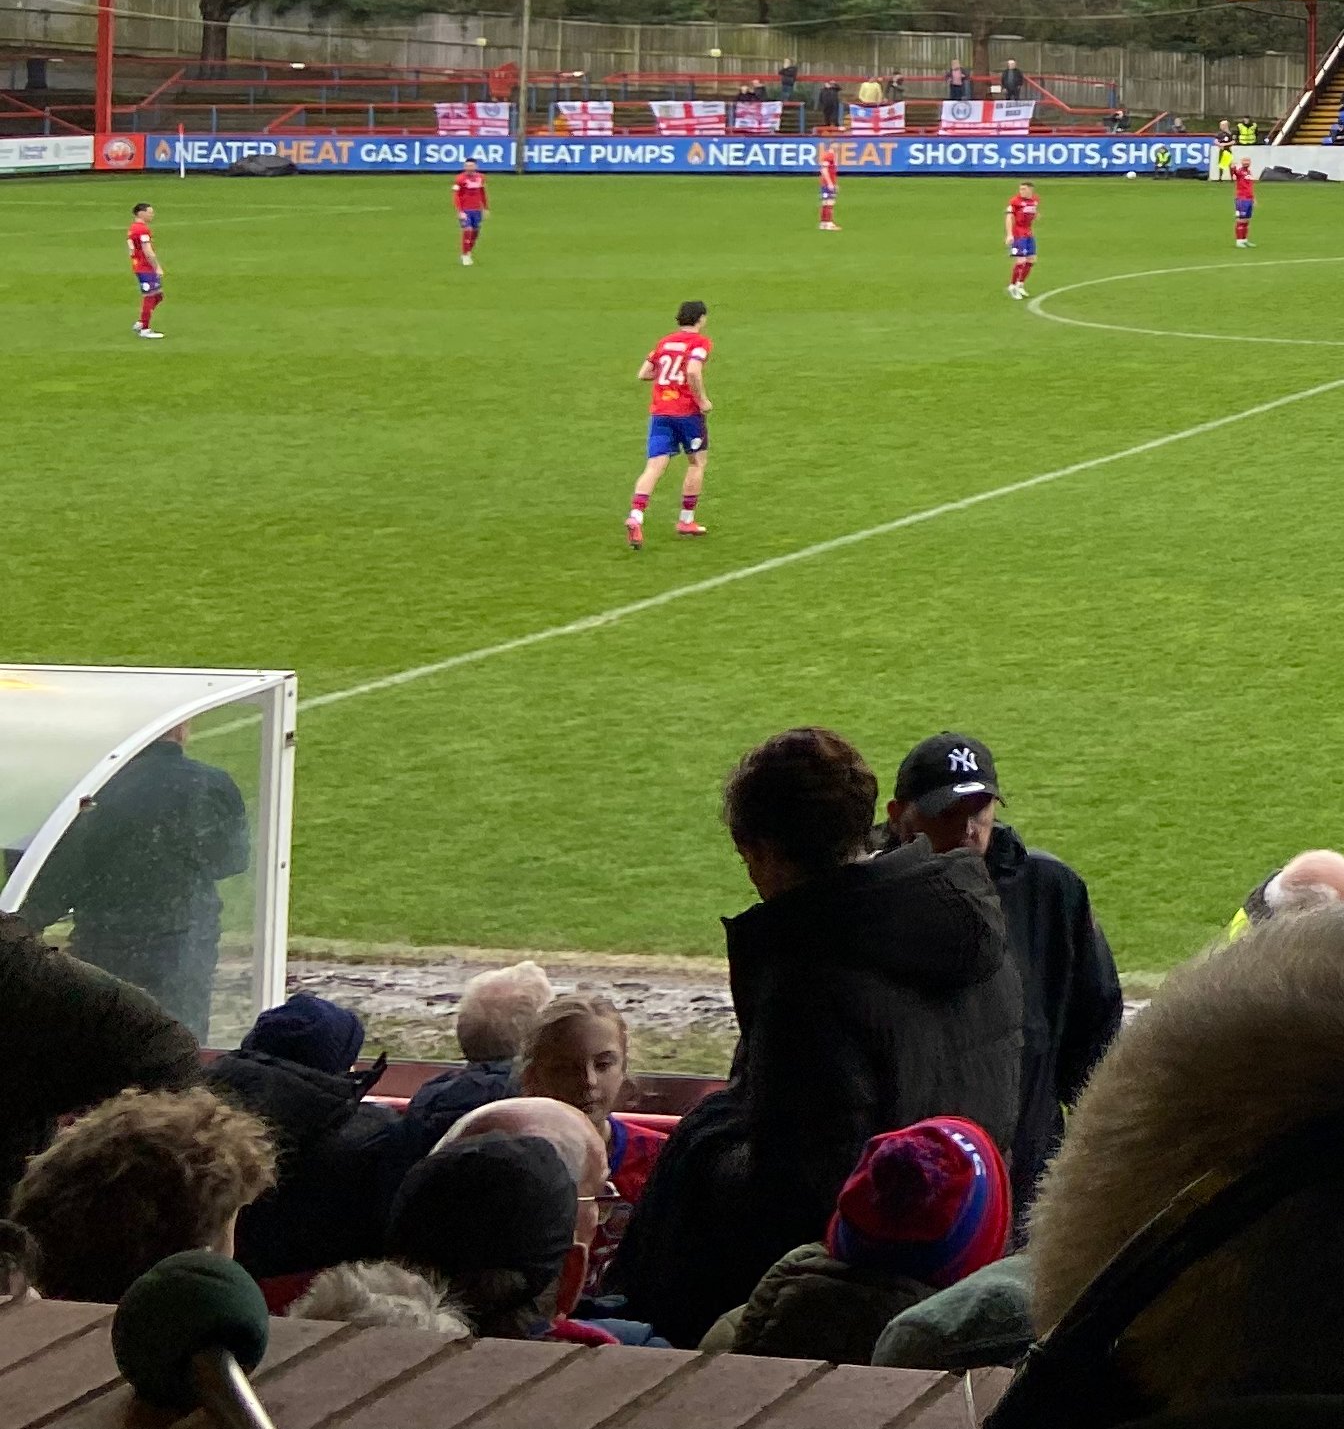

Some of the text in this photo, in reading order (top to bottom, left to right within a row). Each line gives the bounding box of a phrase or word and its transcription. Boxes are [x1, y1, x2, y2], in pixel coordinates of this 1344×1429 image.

[279, 140, 354, 164] HEAT
[360, 143, 407, 163] GAS
[425, 144, 504, 163] SOLAR
[523, 144, 587, 164] HEAT
[591, 144, 675, 164] PUMPS
[709, 143, 817, 166] NEATER
[658, 354, 684, 386] 24
